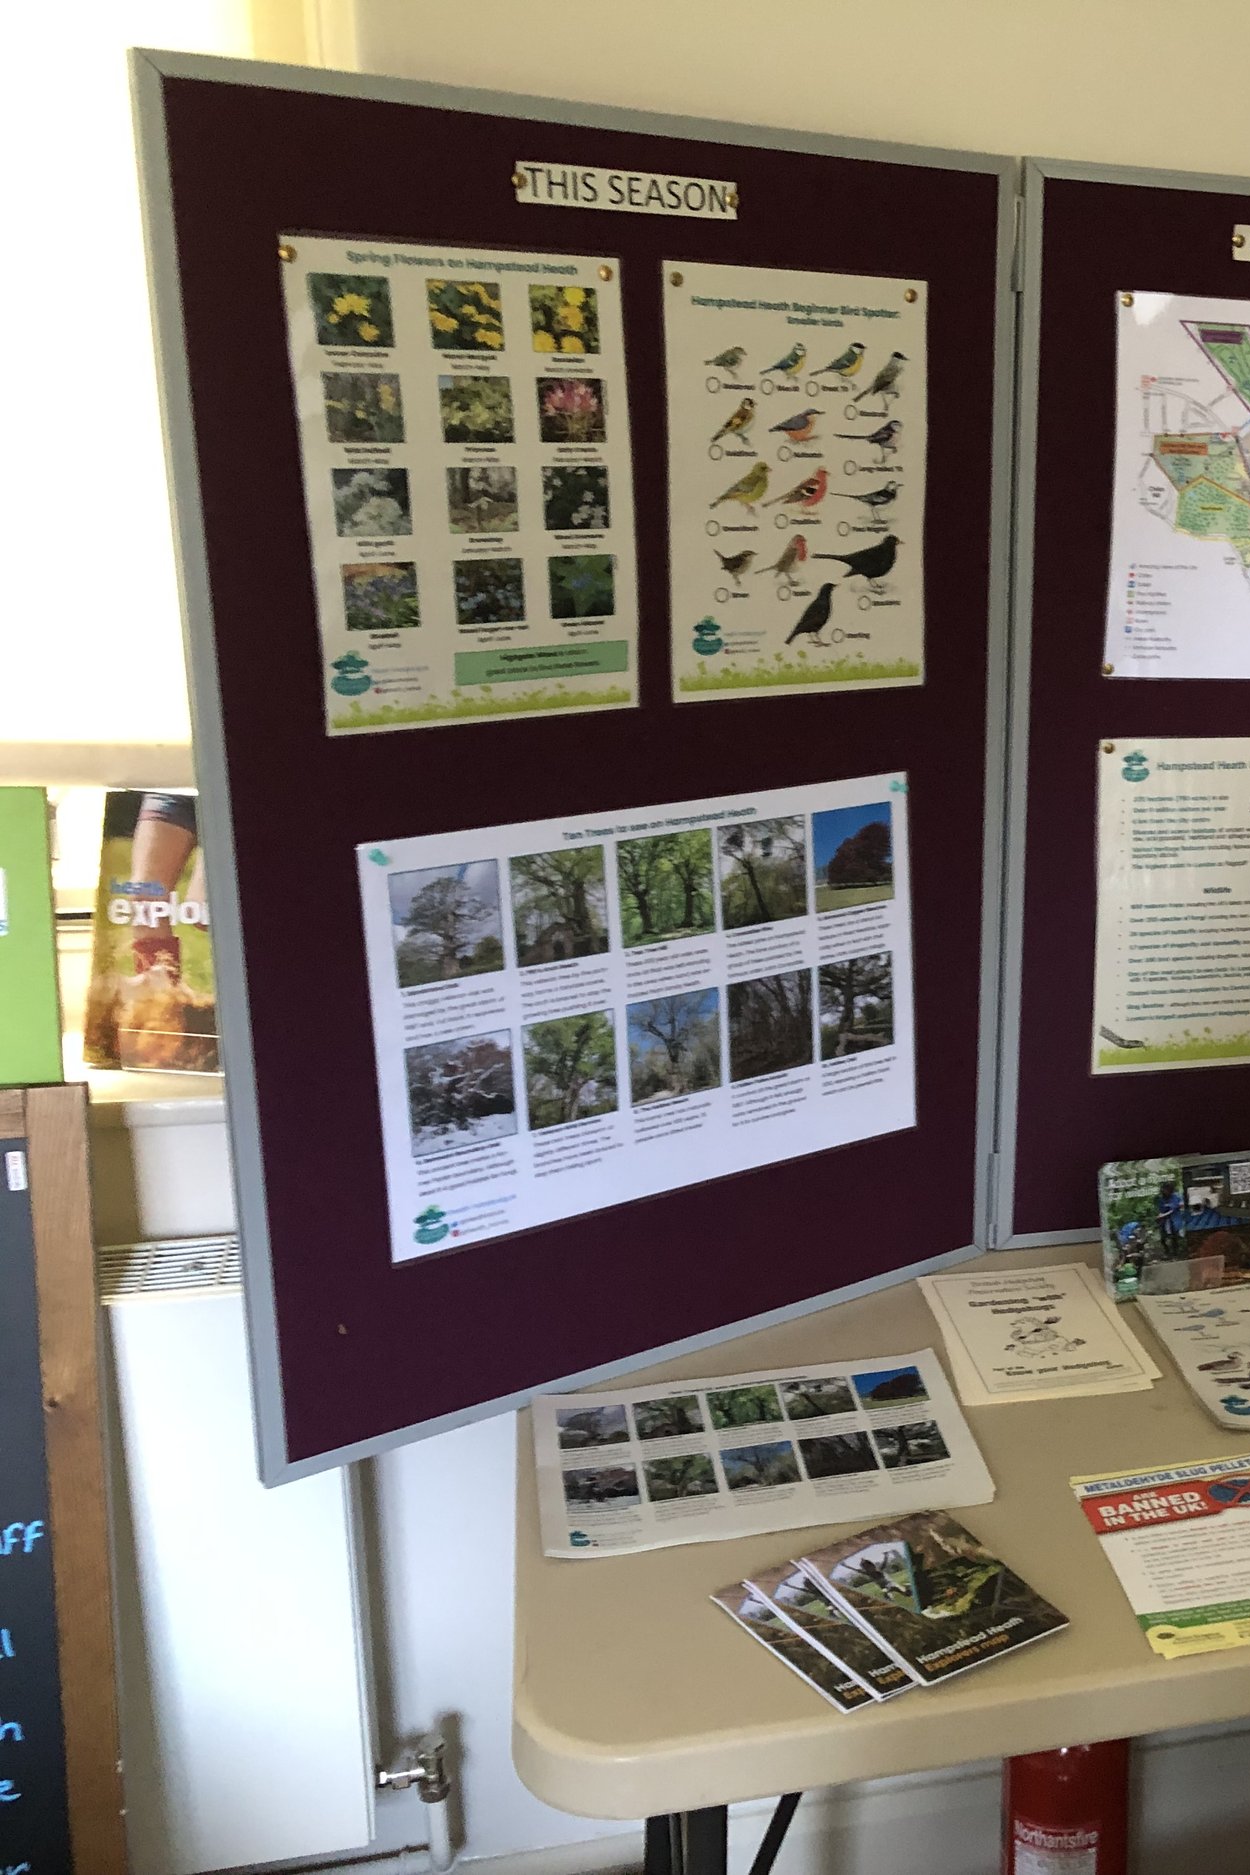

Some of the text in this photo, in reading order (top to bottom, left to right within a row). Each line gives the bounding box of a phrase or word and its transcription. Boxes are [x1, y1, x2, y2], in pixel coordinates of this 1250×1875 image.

[523, 166, 728, 213] THIS SEASON
[347, 251, 392, 268] Spring
[393, 253, 445, 268] Flowers
[466, 259, 540, 273] Hampstead
[542, 263, 578, 275] Heath
[1156, 760, 1215, 772] Hampstead
[1217, 760, 1247, 770] Heath
[1084, 1472, 1174, 1494] METALDEHYDE
[1175, 1467, 1208, 1480] SLUG
[1098, 1492, 1201, 1518] BANNED
[1133, 1491, 1156, 1501] ARE
[1104, 1501, 1208, 1526] IN THE UK!
[915, 1616, 1025, 1663] Hampstead Heath
